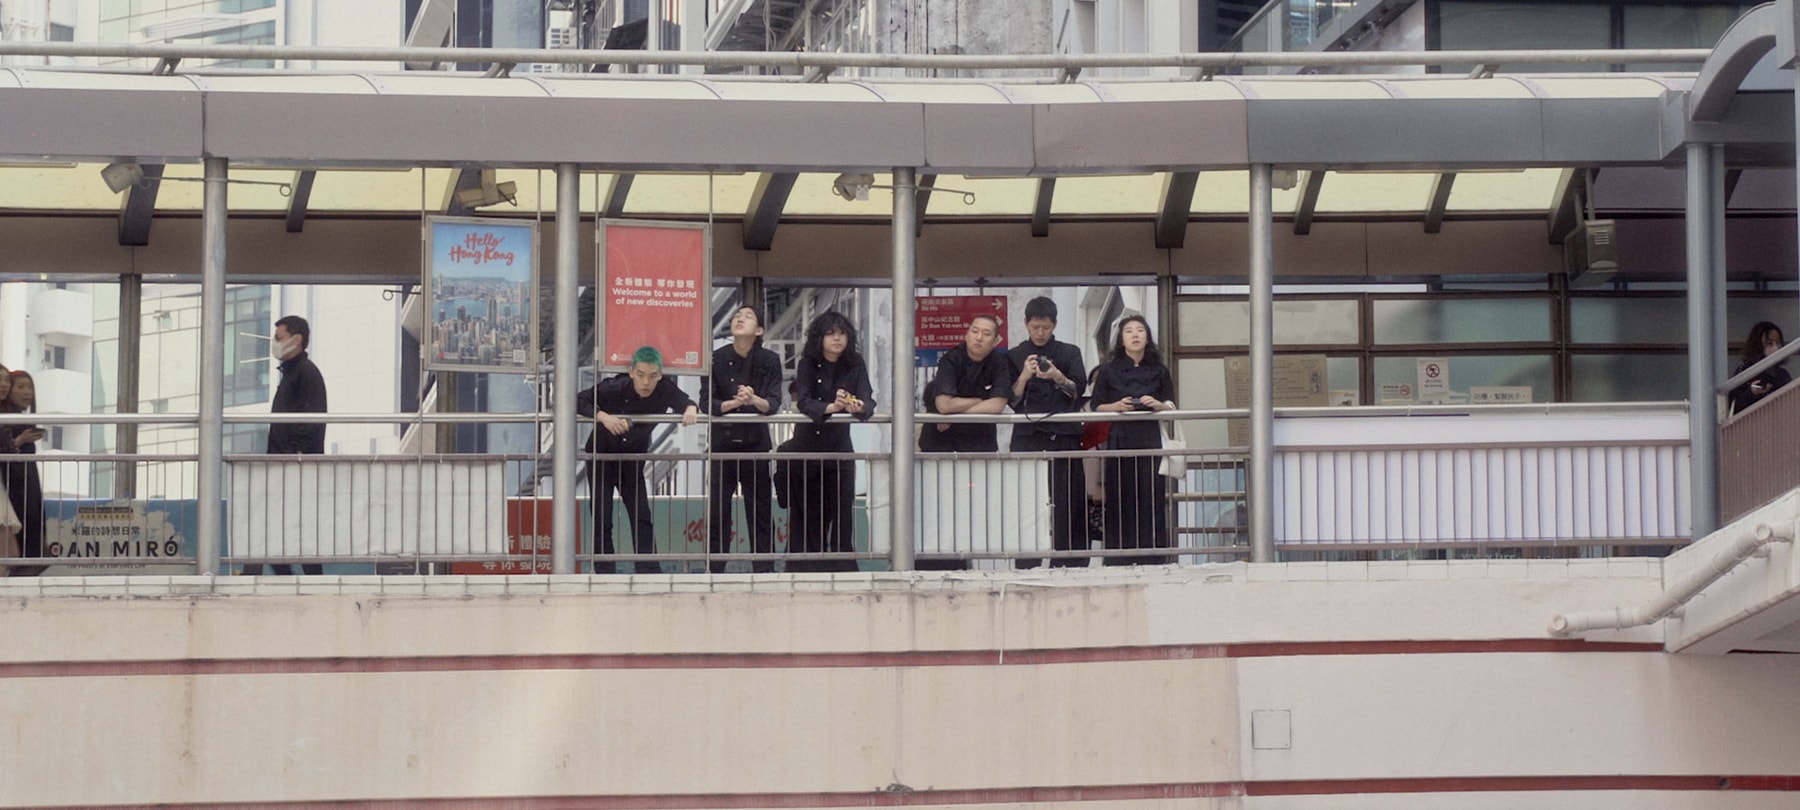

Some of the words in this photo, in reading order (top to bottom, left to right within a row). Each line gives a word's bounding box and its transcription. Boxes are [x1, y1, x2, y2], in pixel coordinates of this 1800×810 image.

[464, 231, 506, 250] Hello
[448, 245, 482, 265] Hong
[483, 246, 514, 266] Kong
[615, 277, 653, 287] 全新體驗
[657, 279, 695, 289] 等你發現
[612, 288, 652, 297] Welcome
[646, 299, 694, 308] discoveries
[71, 525, 141, 536] 米羅的詩想日常
[49, 541, 100, 558] OAN
[113, 536, 179, 558] MIRÓ
